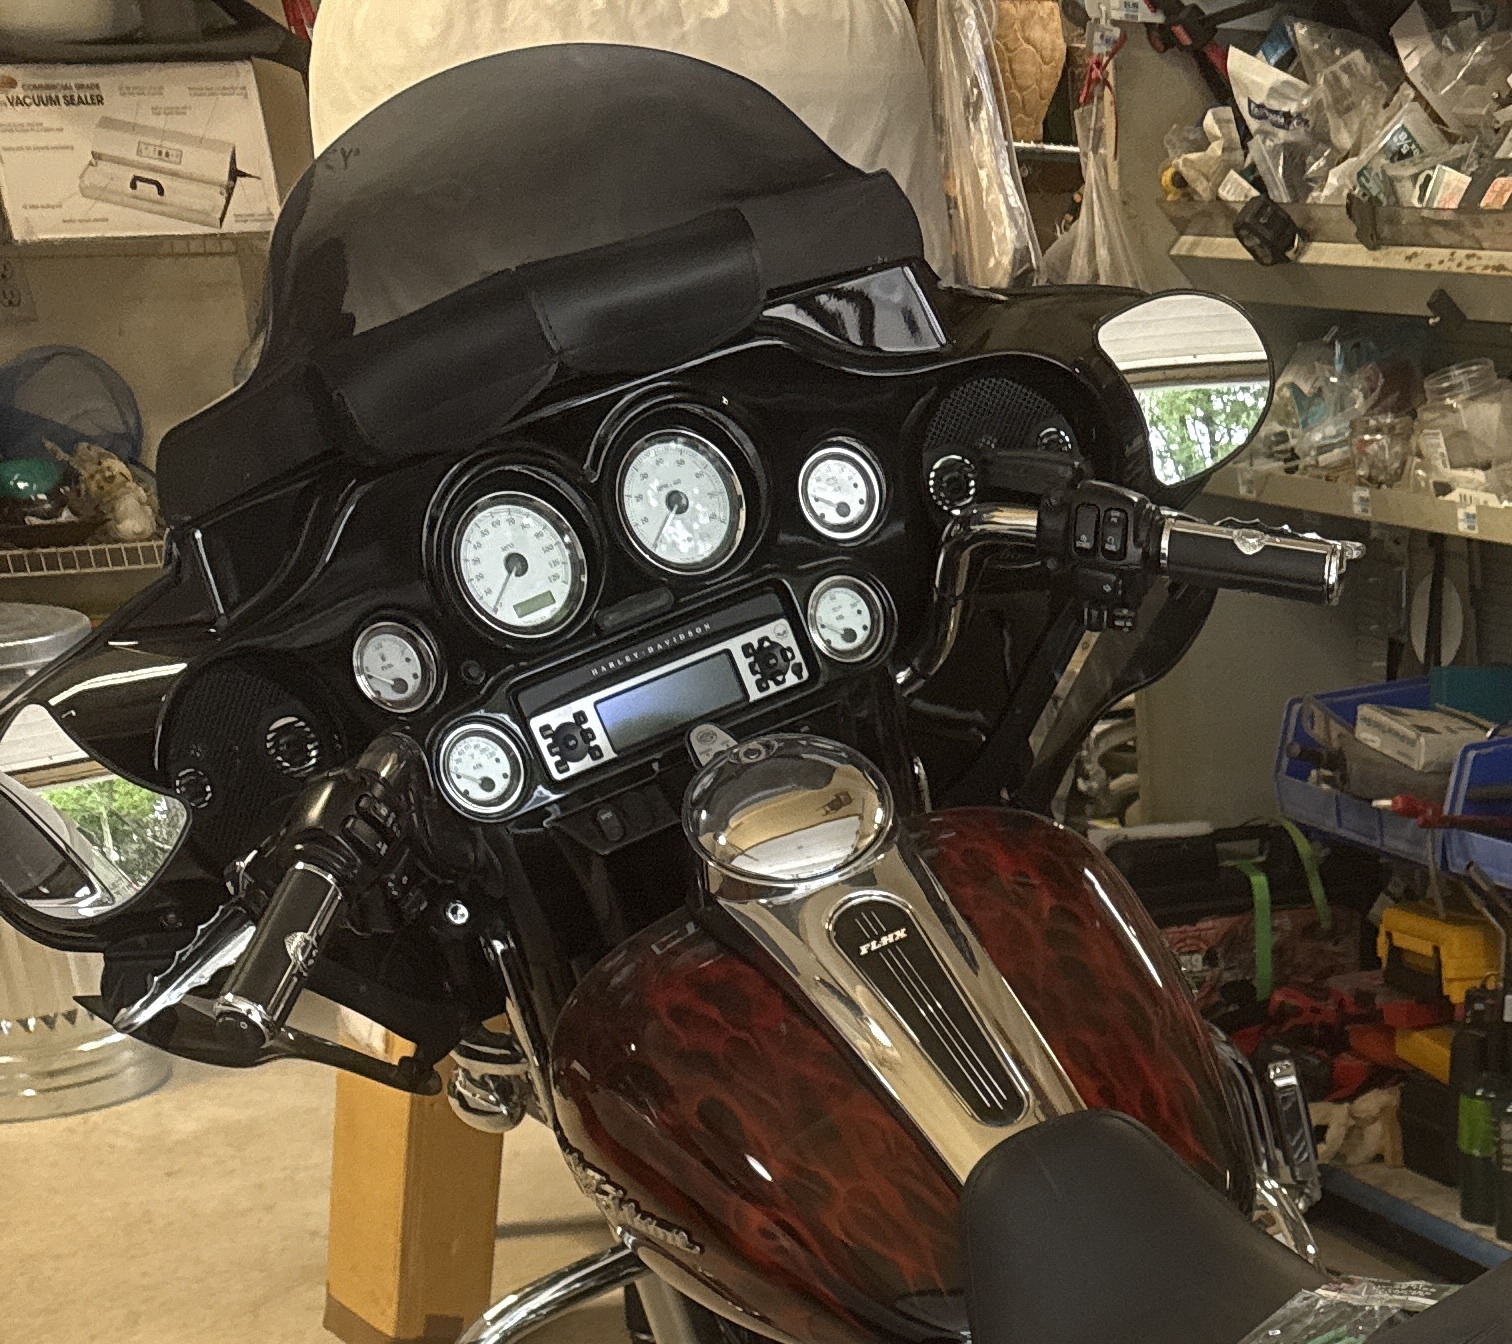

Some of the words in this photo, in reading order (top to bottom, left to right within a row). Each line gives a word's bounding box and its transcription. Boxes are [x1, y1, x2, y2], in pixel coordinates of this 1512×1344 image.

[6, 94, 61, 107] VACUUM
[62, 93, 104, 106] SEALER
[859, 927, 908, 956] FLHX
